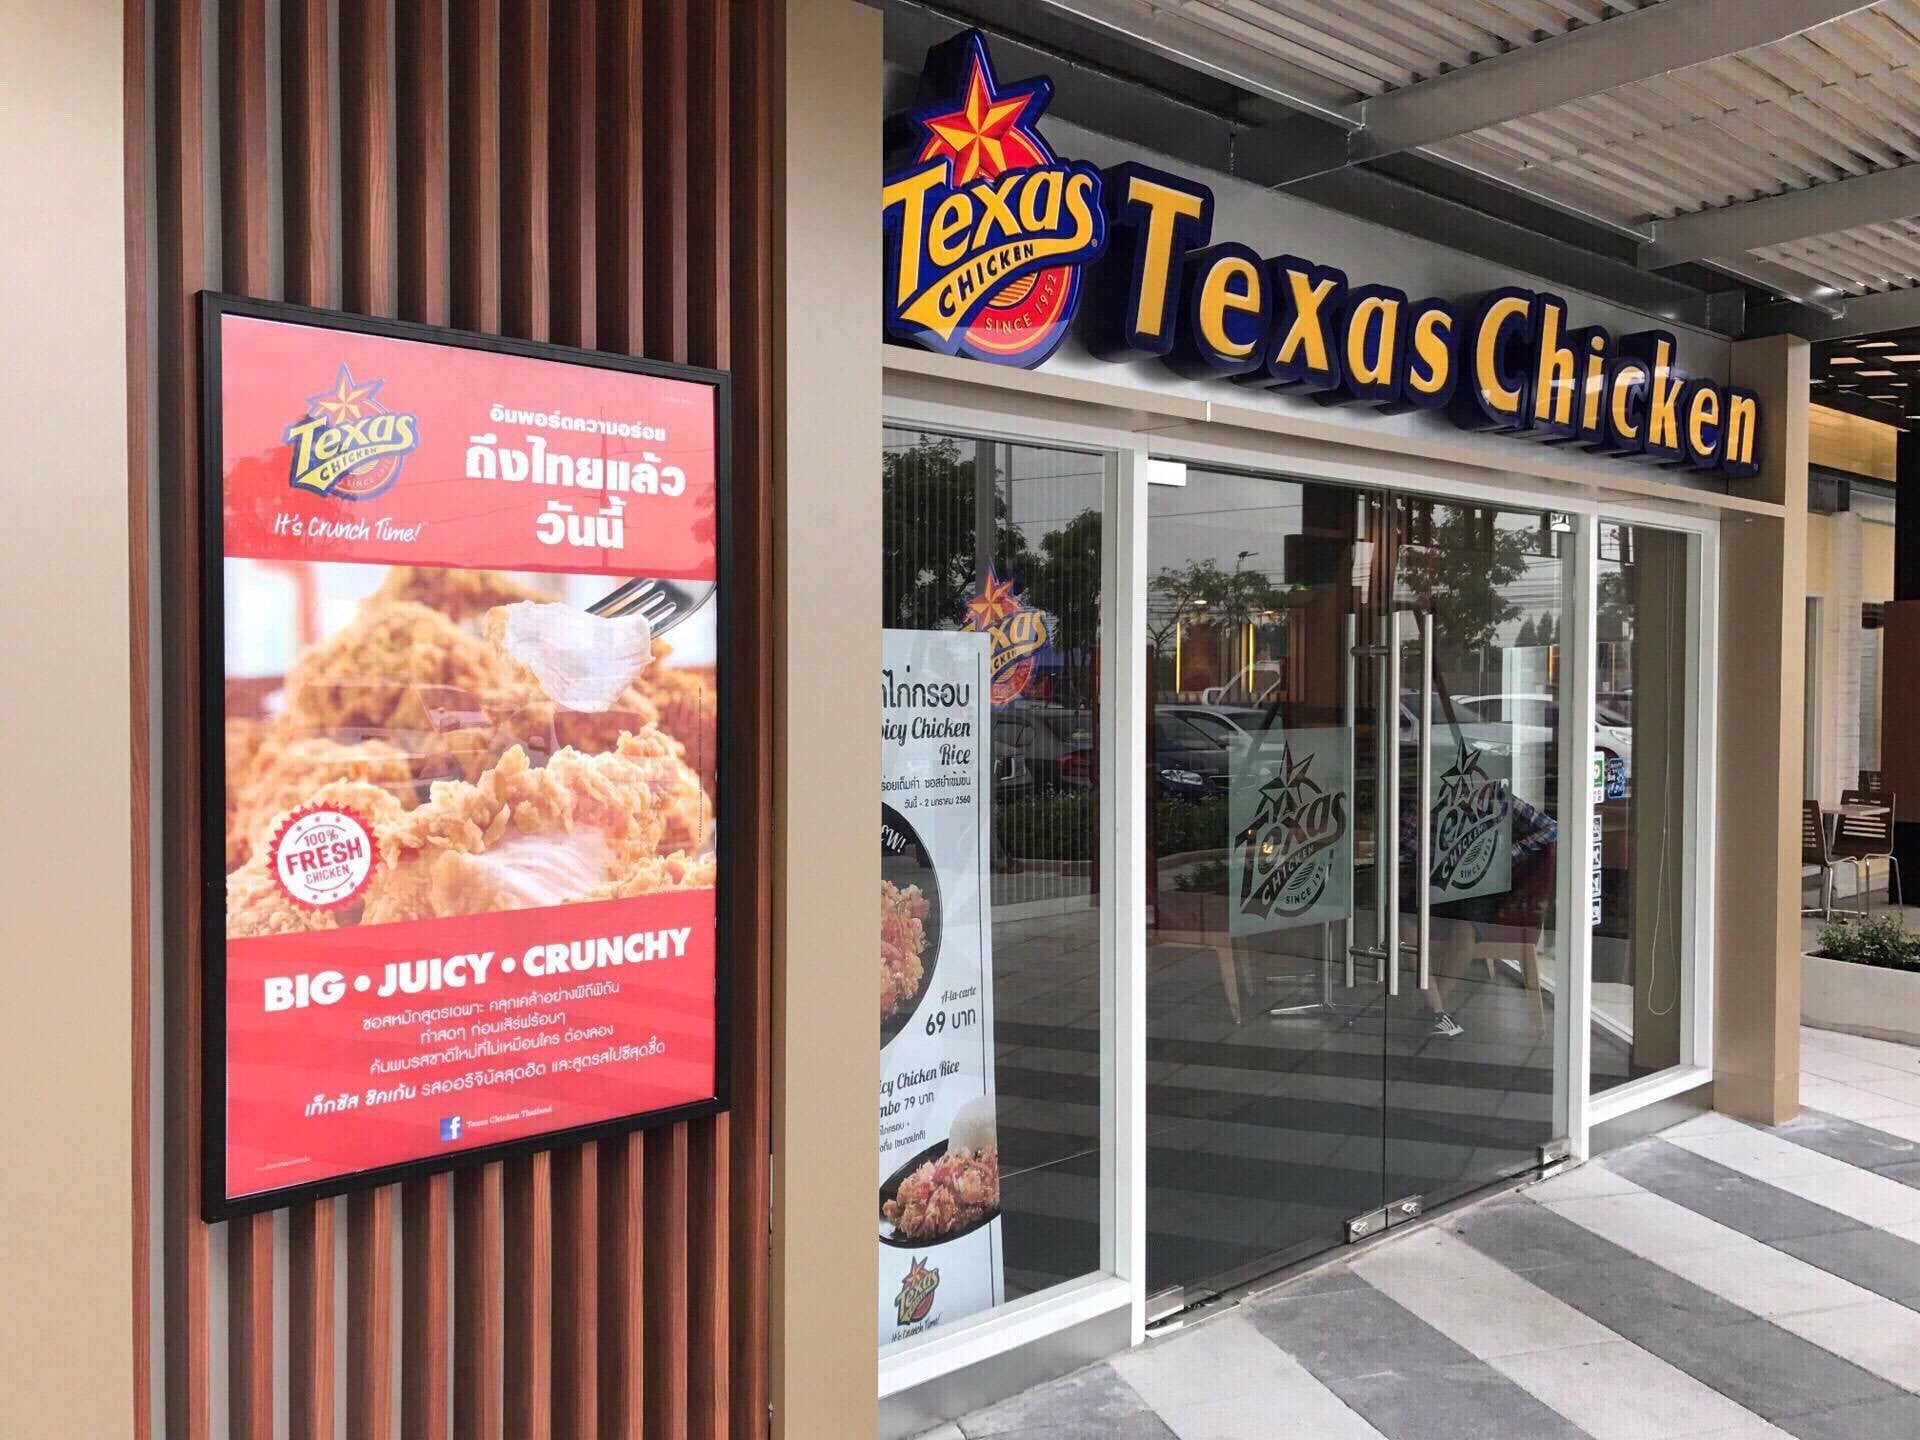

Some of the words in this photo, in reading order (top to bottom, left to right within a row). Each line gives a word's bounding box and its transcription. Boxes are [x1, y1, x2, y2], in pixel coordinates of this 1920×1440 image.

[882, 162, 1094, 309] Texas
[937, 243, 1034, 318] CHICKEN
[985, 312, 1033, 335] SINCE
[1035, 273, 1057, 315] 1952
[1128, 176, 1453, 393] Texas
[1476, 296, 1757, 464] Chicken
[289, 415, 414, 477] Texas
[319, 446, 378, 481] CHICKEN
[465, 432, 686, 497] ถึงไทยแล้ว
[274, 512, 303, 535] It's
[307, 516, 369, 540] Crunch
[375, 517, 422, 542] Time!
[535, 495, 625, 550] วันนี้
[911, 716, 971, 740] Chicken
[939, 743, 971, 766] Rice
[285, 836, 363, 876] FRESH
[303, 829, 340, 847] 100%
[1234, 791, 1347, 909] Texas
[305, 863, 350, 885] CHICKEN
[1262, 843, 1315, 906] CHICKEN
[1285, 887, 1311, 905] SINCE
[264, 970, 346, 1012] BIG
[376, 951, 495, 998] JUICY
[522, 927, 692, 977] CRUNCHY
[564, 1025, 614, 1043] ต้องลอง
[925, 1010, 946, 1036] 69
[952, 1008, 976, 1029] บาท
[897, 1068, 937, 1090] Chicken
[939, 1060, 960, 1077] Rice
[904, 1096, 916, 1110] 79
[919, 1091, 935, 1105] บาท
